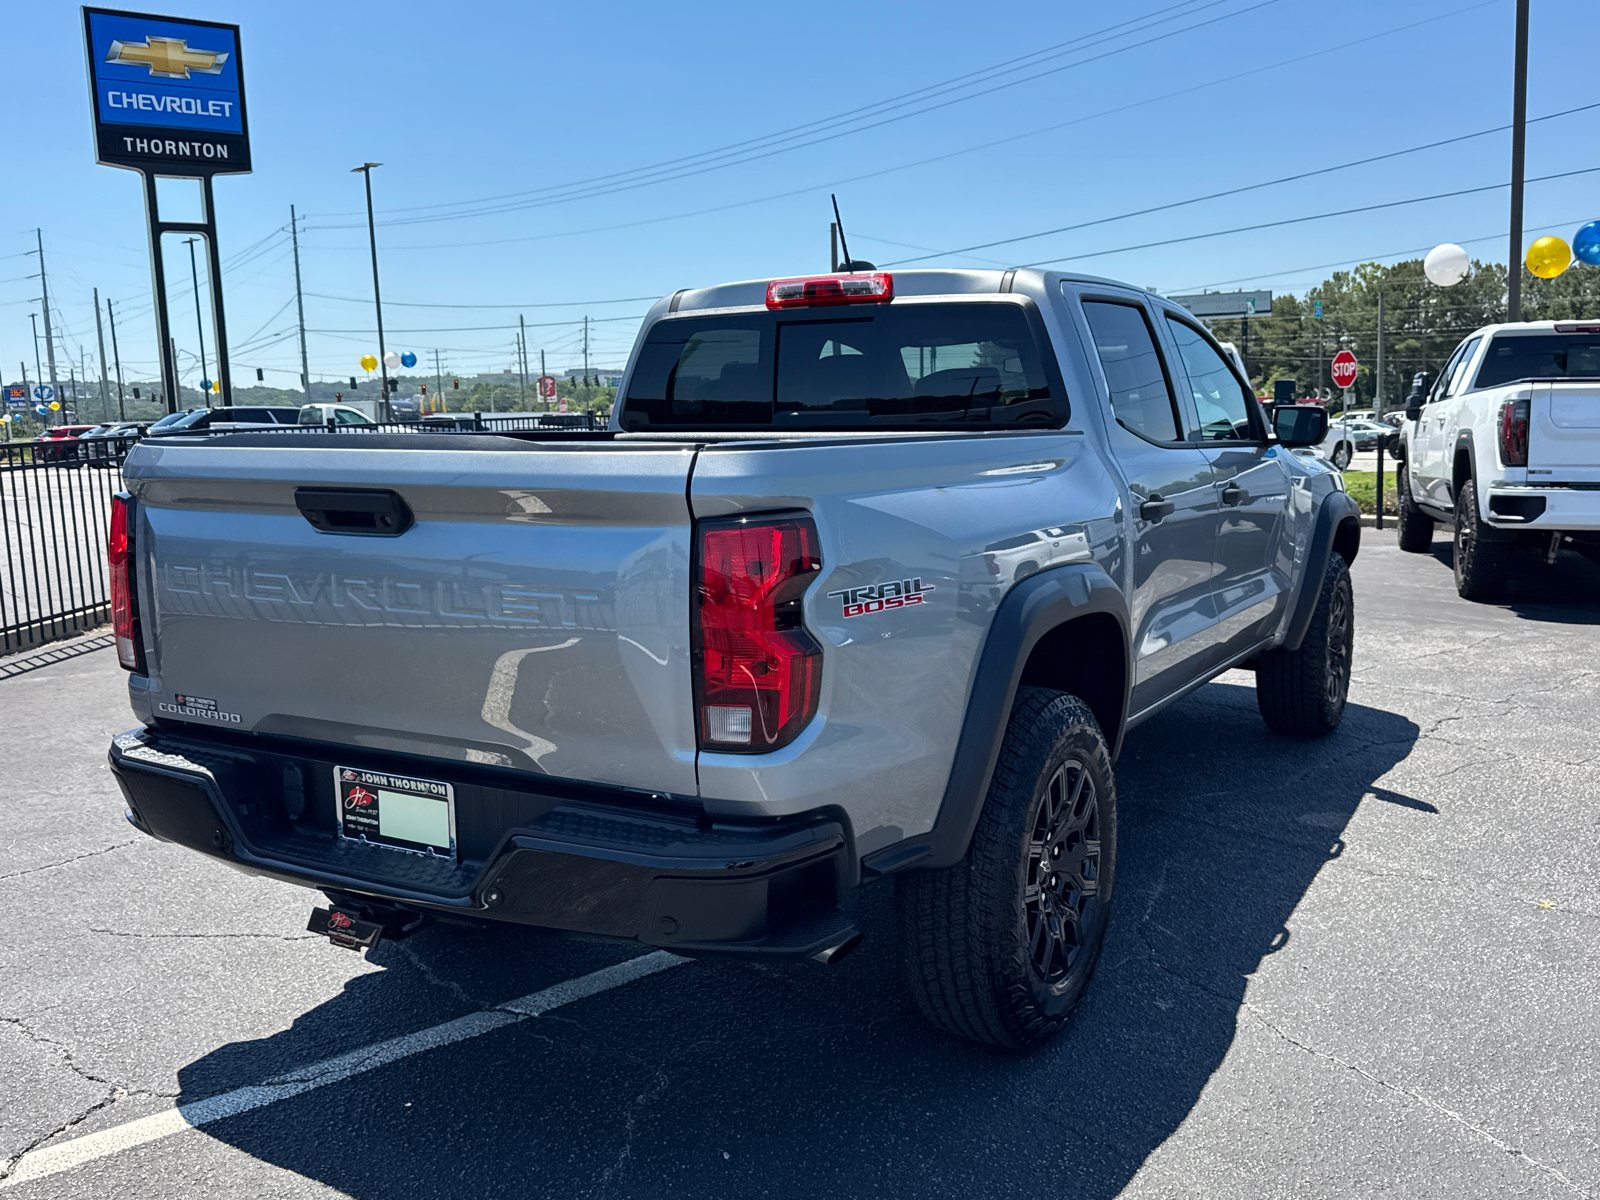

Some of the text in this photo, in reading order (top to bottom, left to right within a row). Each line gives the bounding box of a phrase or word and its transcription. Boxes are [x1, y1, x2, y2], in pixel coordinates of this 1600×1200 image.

[107, 91, 234, 118] CHEVROLET
[123, 136, 229, 159] THORNTON
[1333, 361, 1356, 377] STOP
[164, 562, 604, 627] CHEVROLET
[827, 576, 936, 605] TRAIL
[842, 592, 924, 619] BOSS
[158, 702, 241, 723] COLORADO
[361, 772, 388, 786] JOHN
[389, 777, 446, 795] THORNTON
[356, 816, 379, 826] THORNTON
